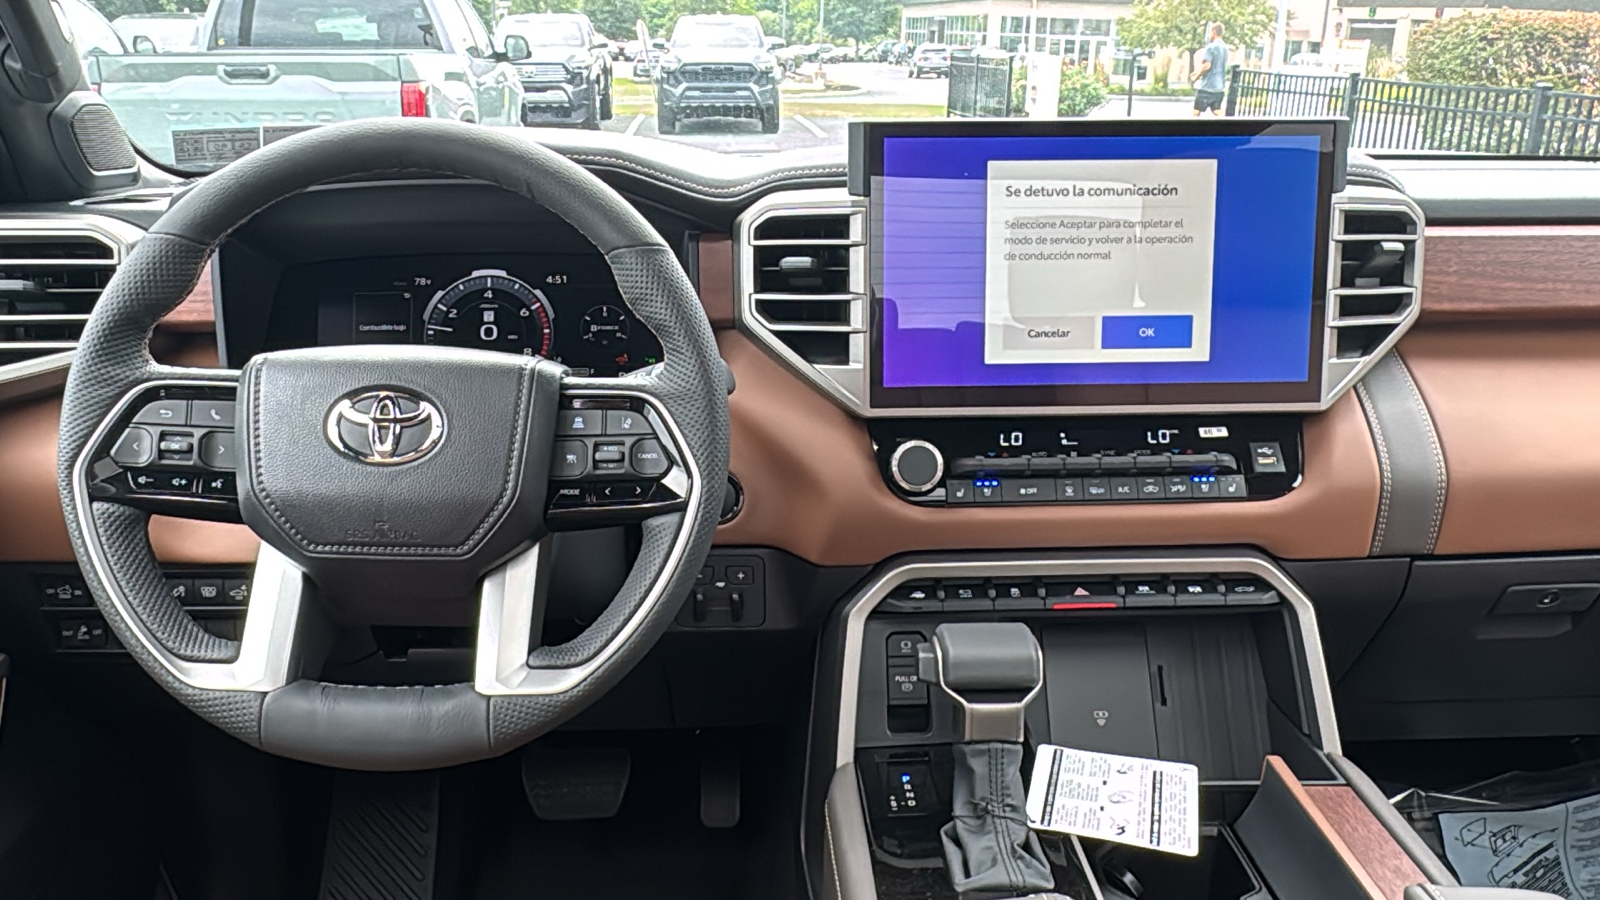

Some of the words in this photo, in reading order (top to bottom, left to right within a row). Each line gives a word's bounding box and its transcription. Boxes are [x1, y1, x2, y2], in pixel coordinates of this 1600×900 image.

[1005, 185, 1021, 197] Se
[1024, 185, 1070, 197] detuvo
[1072, 184, 1085, 197] la
[1087, 184, 1178, 197] comunicación
[1005, 219, 1057, 229] Seleccione
[1058, 219, 1097, 231] Aceptar
[1099, 221, 1121, 231] para
[1122, 219, 1173, 231] completar
[1174, 218, 1184, 228] el
[1004, 236, 1034, 245] modo
[1035, 235, 1048, 245] de
[1050, 235, 1086, 245] servicio
[1087, 237, 1094, 247] y
[1095, 234, 1124, 245] volver
[1126, 236, 1132, 244] a
[1134, 234, 1143, 244] la
[1145, 234, 1194, 246] operación
[1004, 251, 1017, 261] de
[1018, 250, 1075, 261] conducción
[1077, 250, 1112, 260] normal
[546, 275, 567, 284] 4:51
[483, 290, 493, 299] 4
[448, 308, 458, 318] 2
[520, 308, 530, 317] 6
[480, 324, 498, 341] 0
[1027, 329, 1070, 339] Cancelar
[1139, 328, 1155, 337] OK
[523, 348, 532, 357] 8
[1000, 432, 1023, 446] LO
[1147, 430, 1170, 444] LO
[1027, 487, 1038, 495] OFF
[902, 775, 910, 783] P
